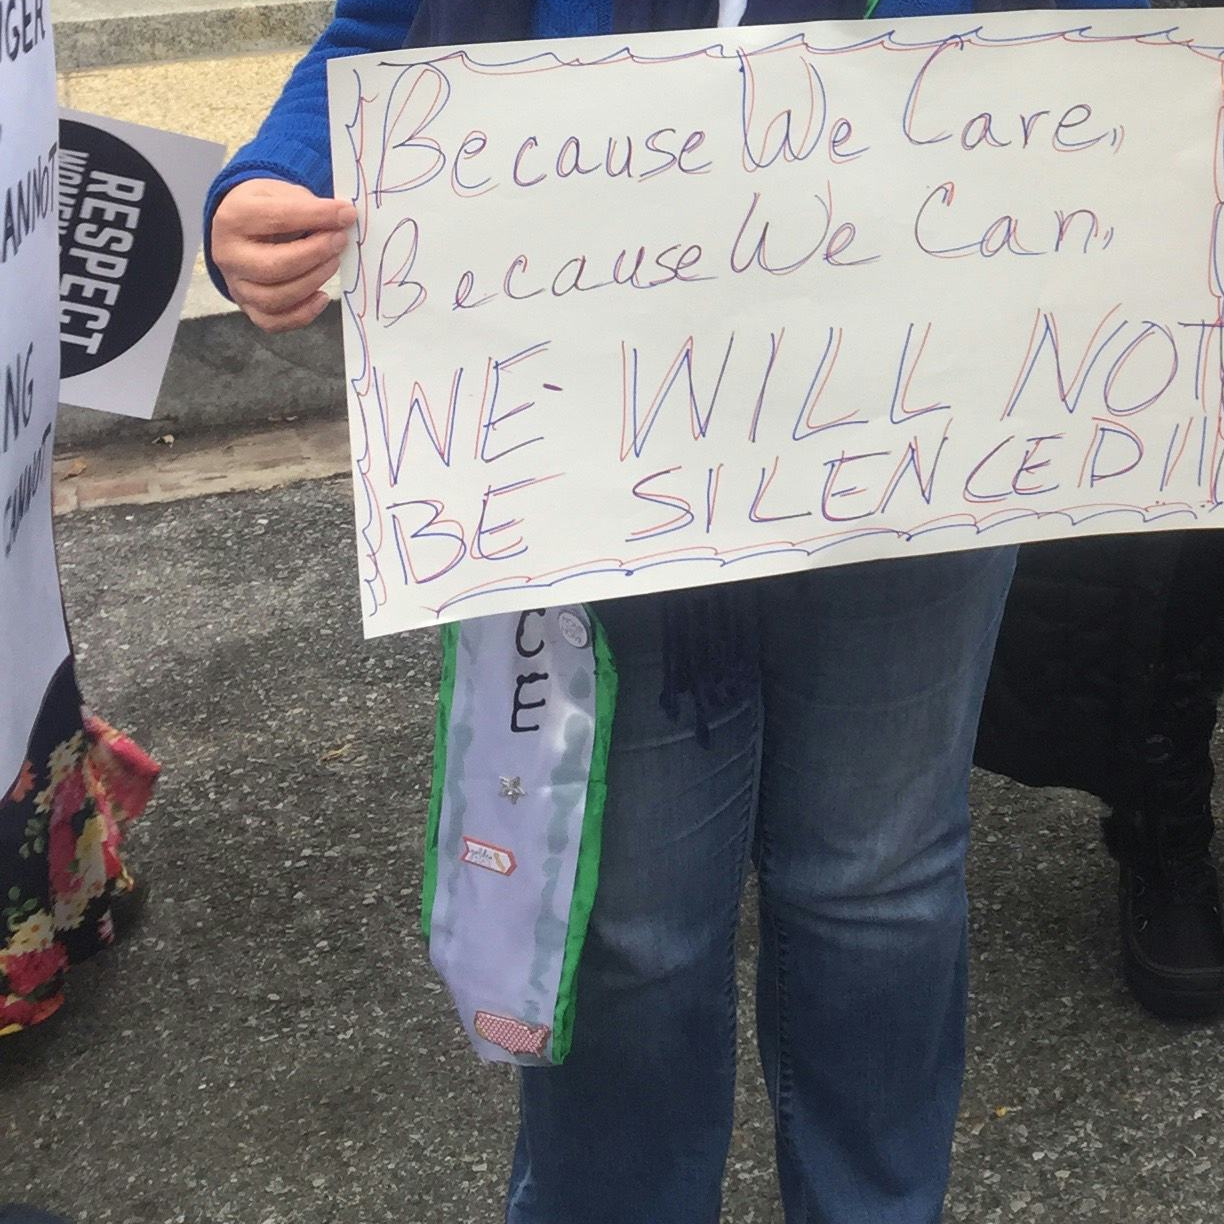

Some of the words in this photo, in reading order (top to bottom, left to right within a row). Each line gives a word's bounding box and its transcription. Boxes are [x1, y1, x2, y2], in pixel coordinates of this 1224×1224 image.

[369, 62, 712, 209] Because
[736, 47, 869, 172] We
[903, 34, 1125, 153] Care,
[59, 170, 146, 356] RESPECT
[375, 217, 722, 328] Because
[730, 180, 881, 275] We
[914, 181, 1115, 259] Can,
[618, 320, 952, 462] WILL
[386, 471, 566, 585] BE
